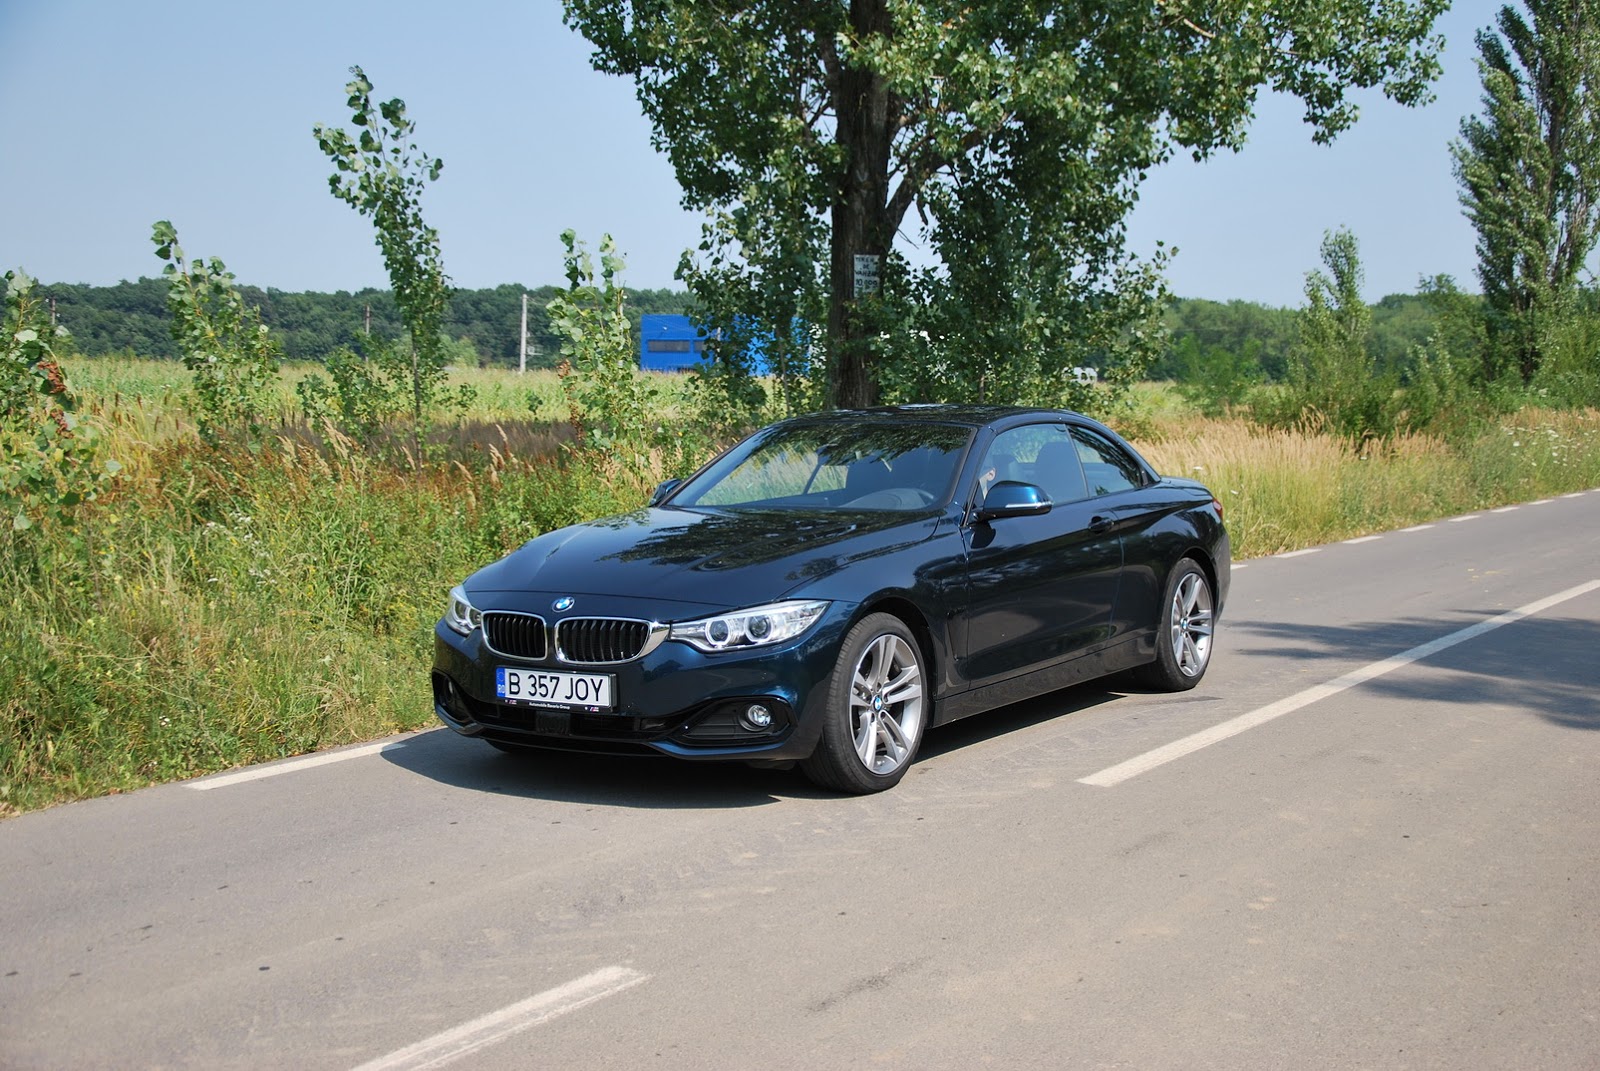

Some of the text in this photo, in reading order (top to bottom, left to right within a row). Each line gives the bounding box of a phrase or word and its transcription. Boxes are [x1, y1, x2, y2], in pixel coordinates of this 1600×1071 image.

[509, 672, 603, 702] B 357 JOY
